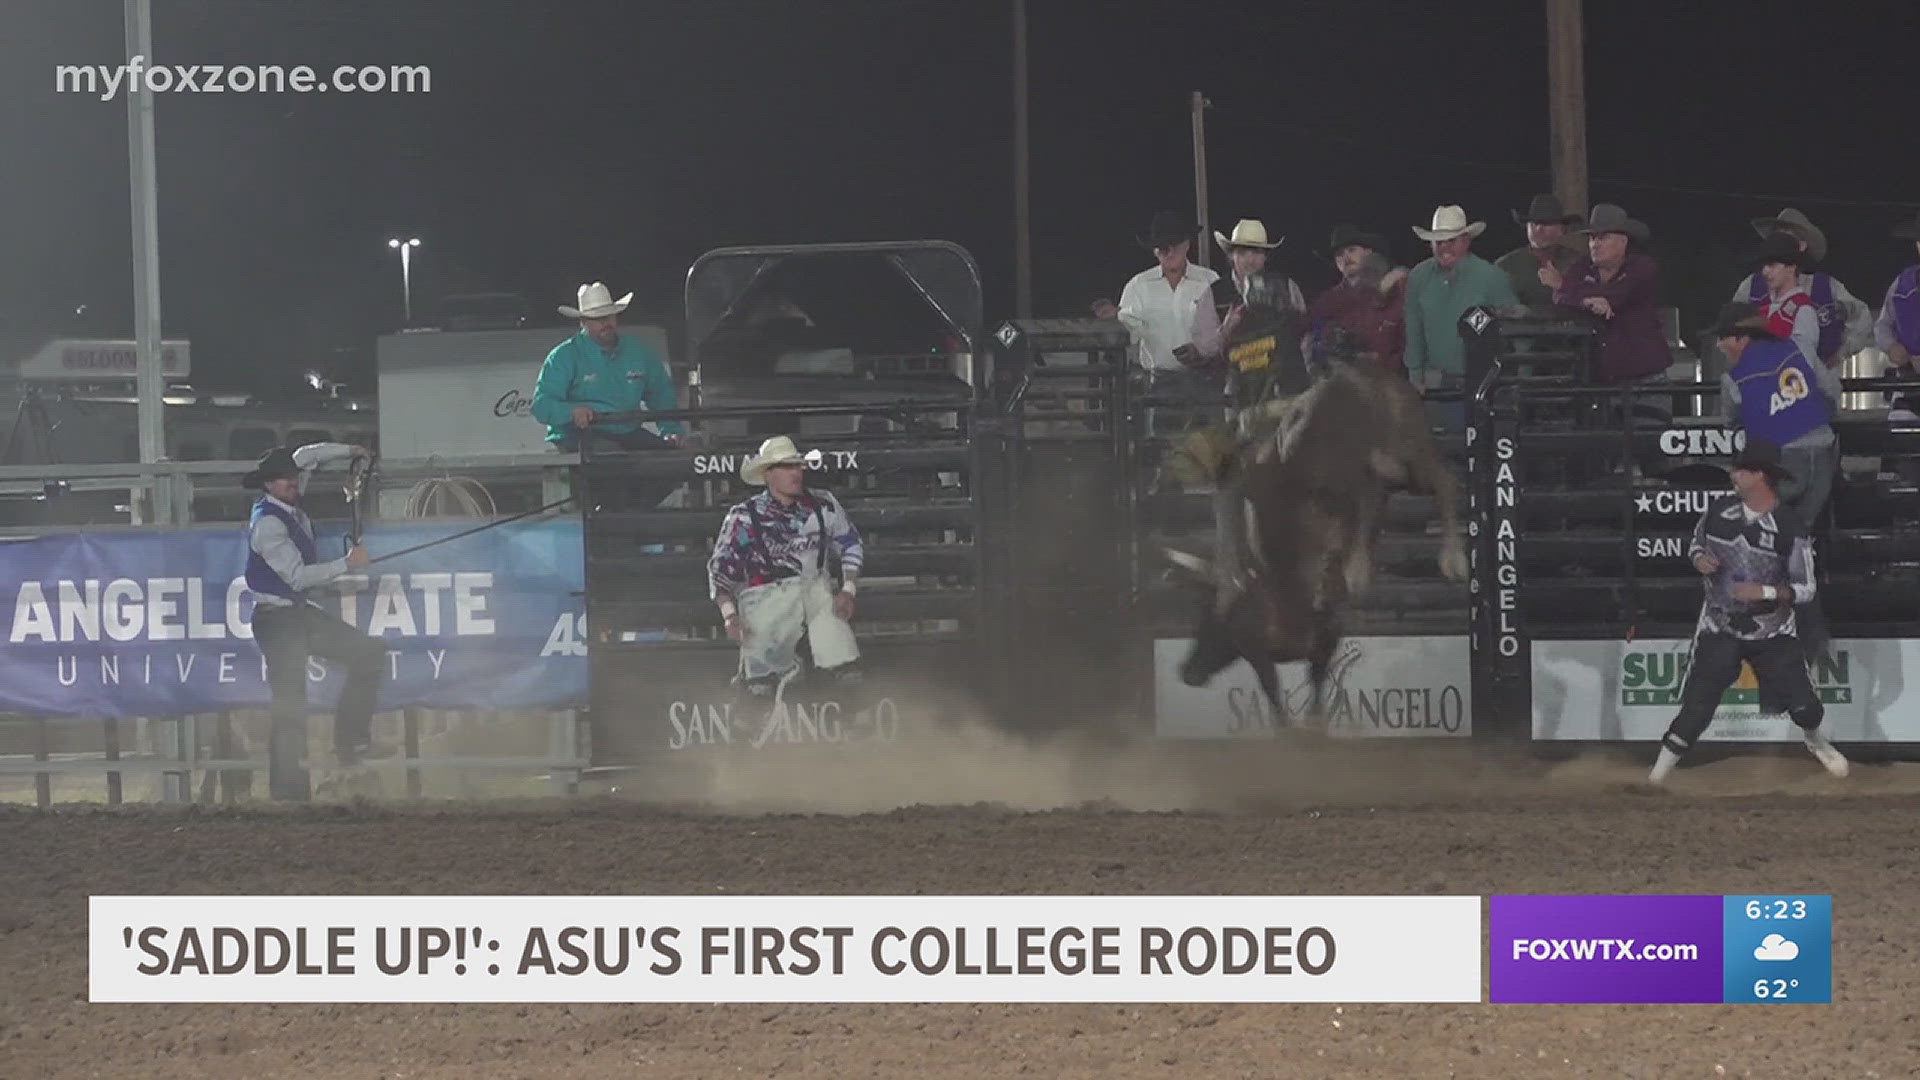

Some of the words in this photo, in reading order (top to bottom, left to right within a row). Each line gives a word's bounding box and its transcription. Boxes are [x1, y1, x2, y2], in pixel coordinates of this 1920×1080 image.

[694, 455, 735, 474] SAN
[831, 451, 858, 470] TX
[1496, 438, 1514, 507] SAN
[1656, 491, 1737, 513] CHUT
[1637, 538, 1681, 558] SAN
[333, 572, 495, 637] TATE
[1497, 519, 1518, 656] ANGELO
[58, 650, 446, 686] UNIVESTY
[669, 701, 739, 749] SAN
[752, 698, 898, 748] ANGO
[1328, 685, 1462, 733] ANGELO
